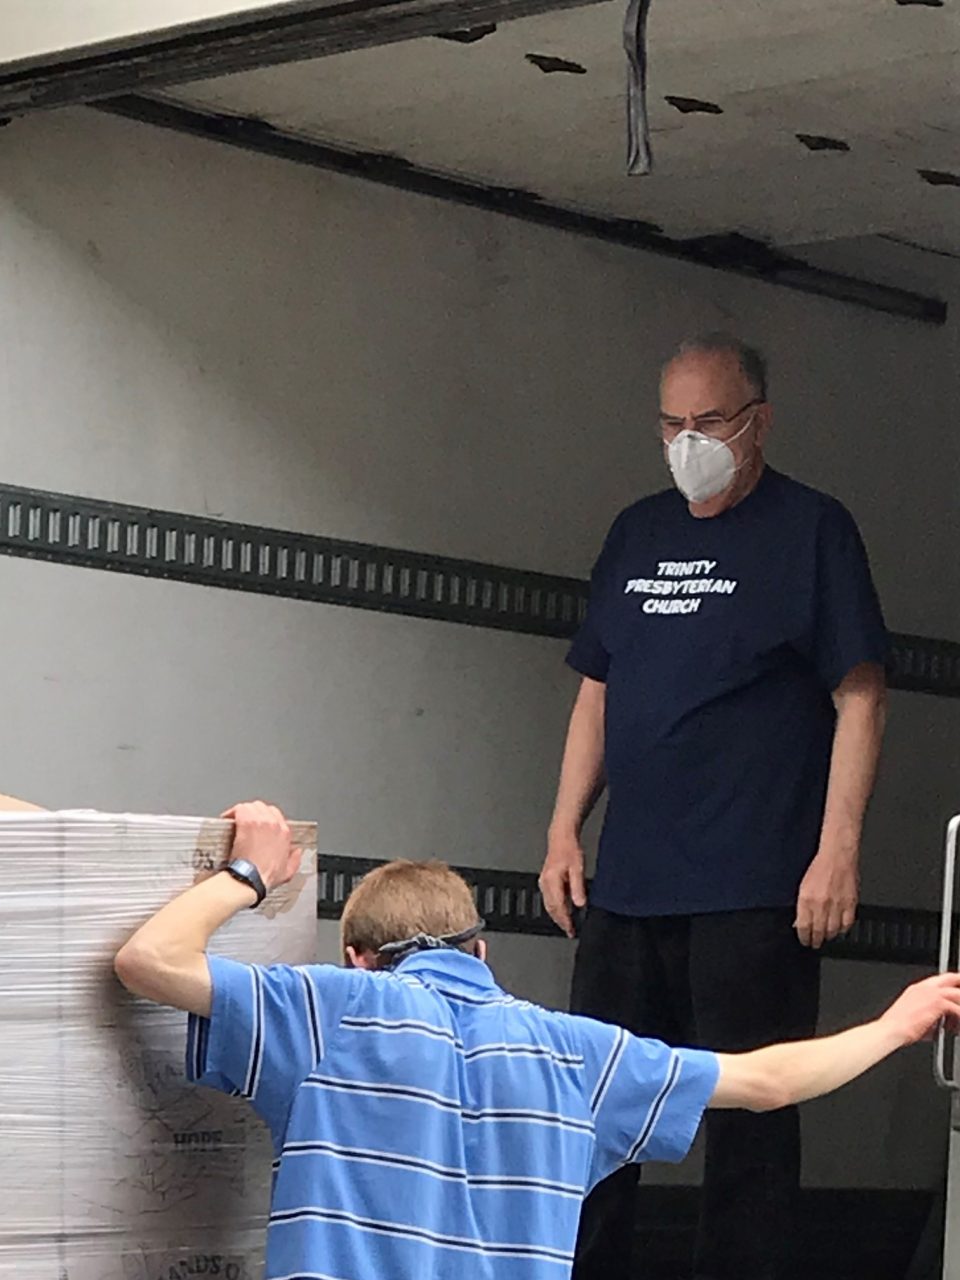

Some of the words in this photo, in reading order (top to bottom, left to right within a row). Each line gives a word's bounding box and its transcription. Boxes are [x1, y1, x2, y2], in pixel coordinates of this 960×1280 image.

[657, 560, 717, 576] TRINITY
[624, 579, 737, 595] PRESBYTERIAN
[642, 598, 701, 614] CHURCH
